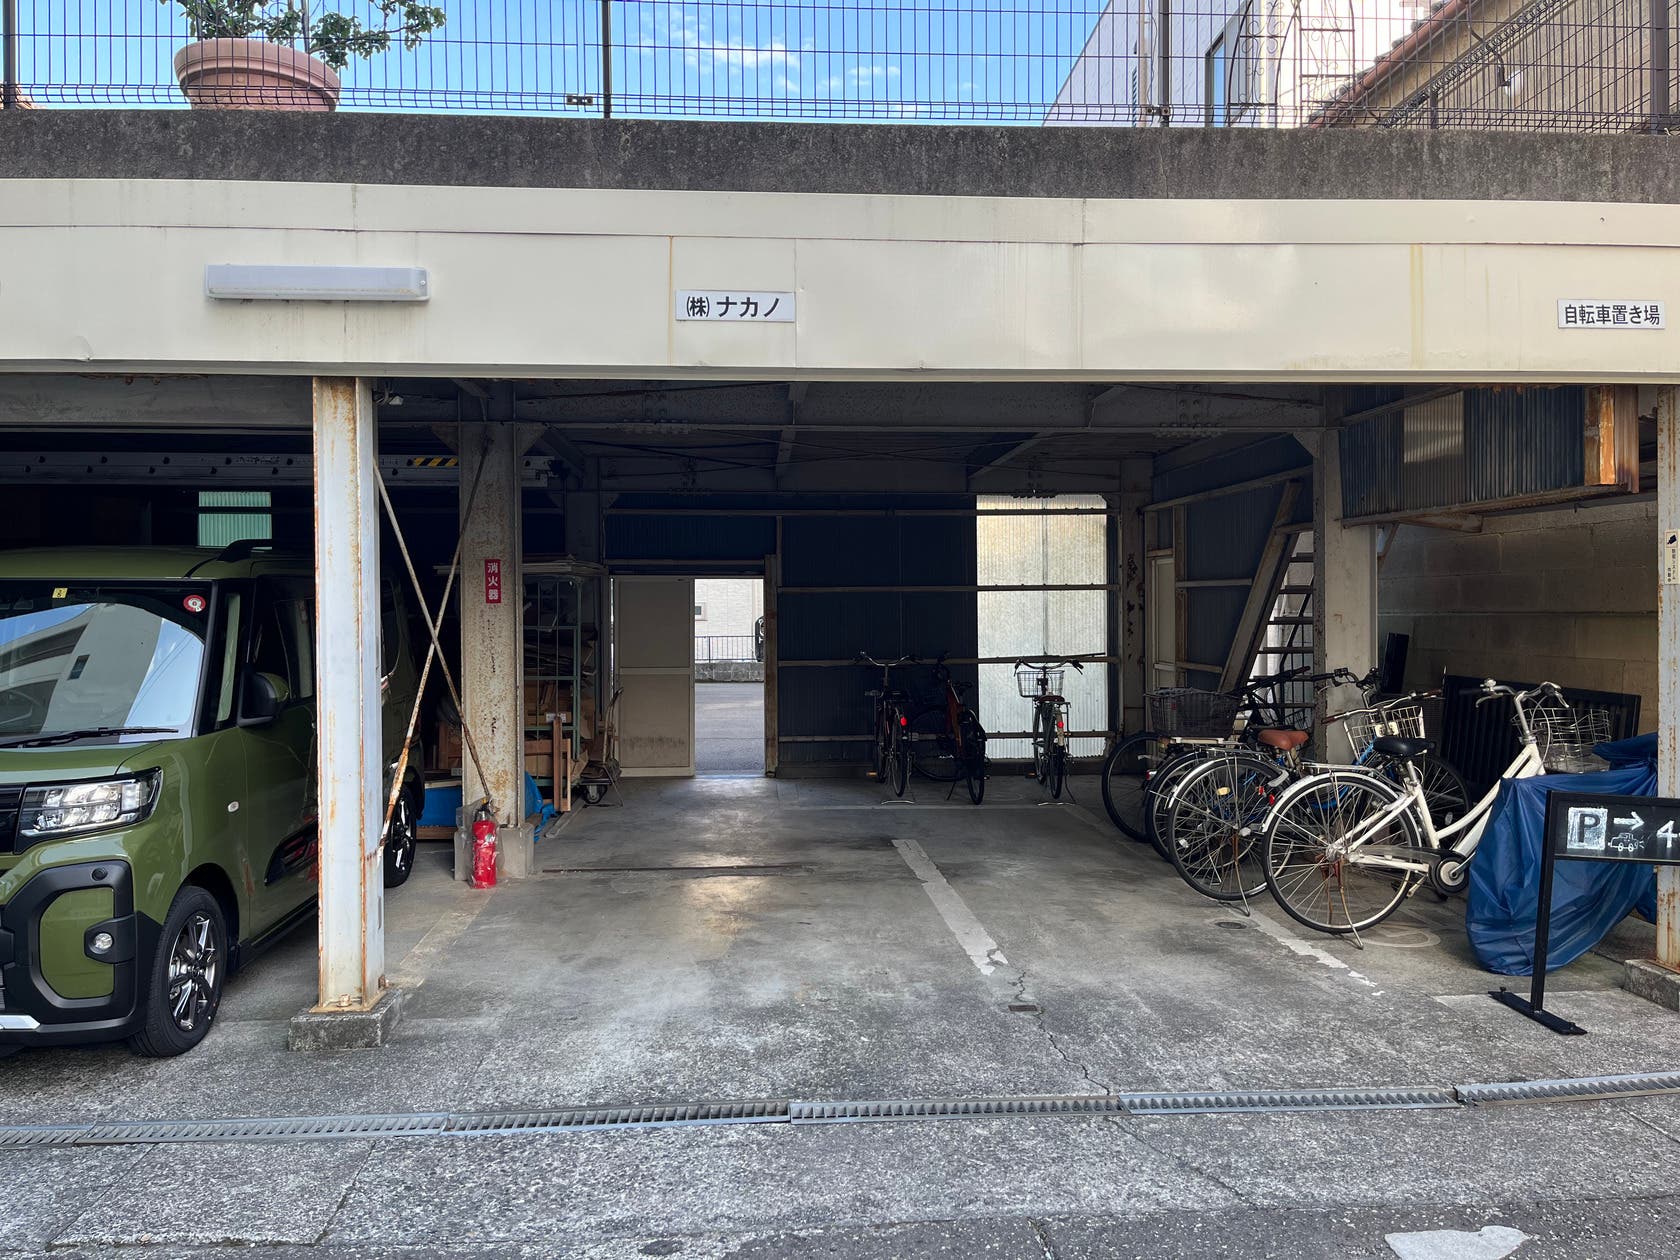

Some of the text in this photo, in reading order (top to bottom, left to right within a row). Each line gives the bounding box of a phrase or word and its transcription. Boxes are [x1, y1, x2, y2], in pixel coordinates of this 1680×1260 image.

[1565, 304, 1660, 325] 自転車置き場
[487, 562, 499, 600] 消火器
[1577, 813, 1601, 843] P
[1656, 820, 1680, 848] 4
